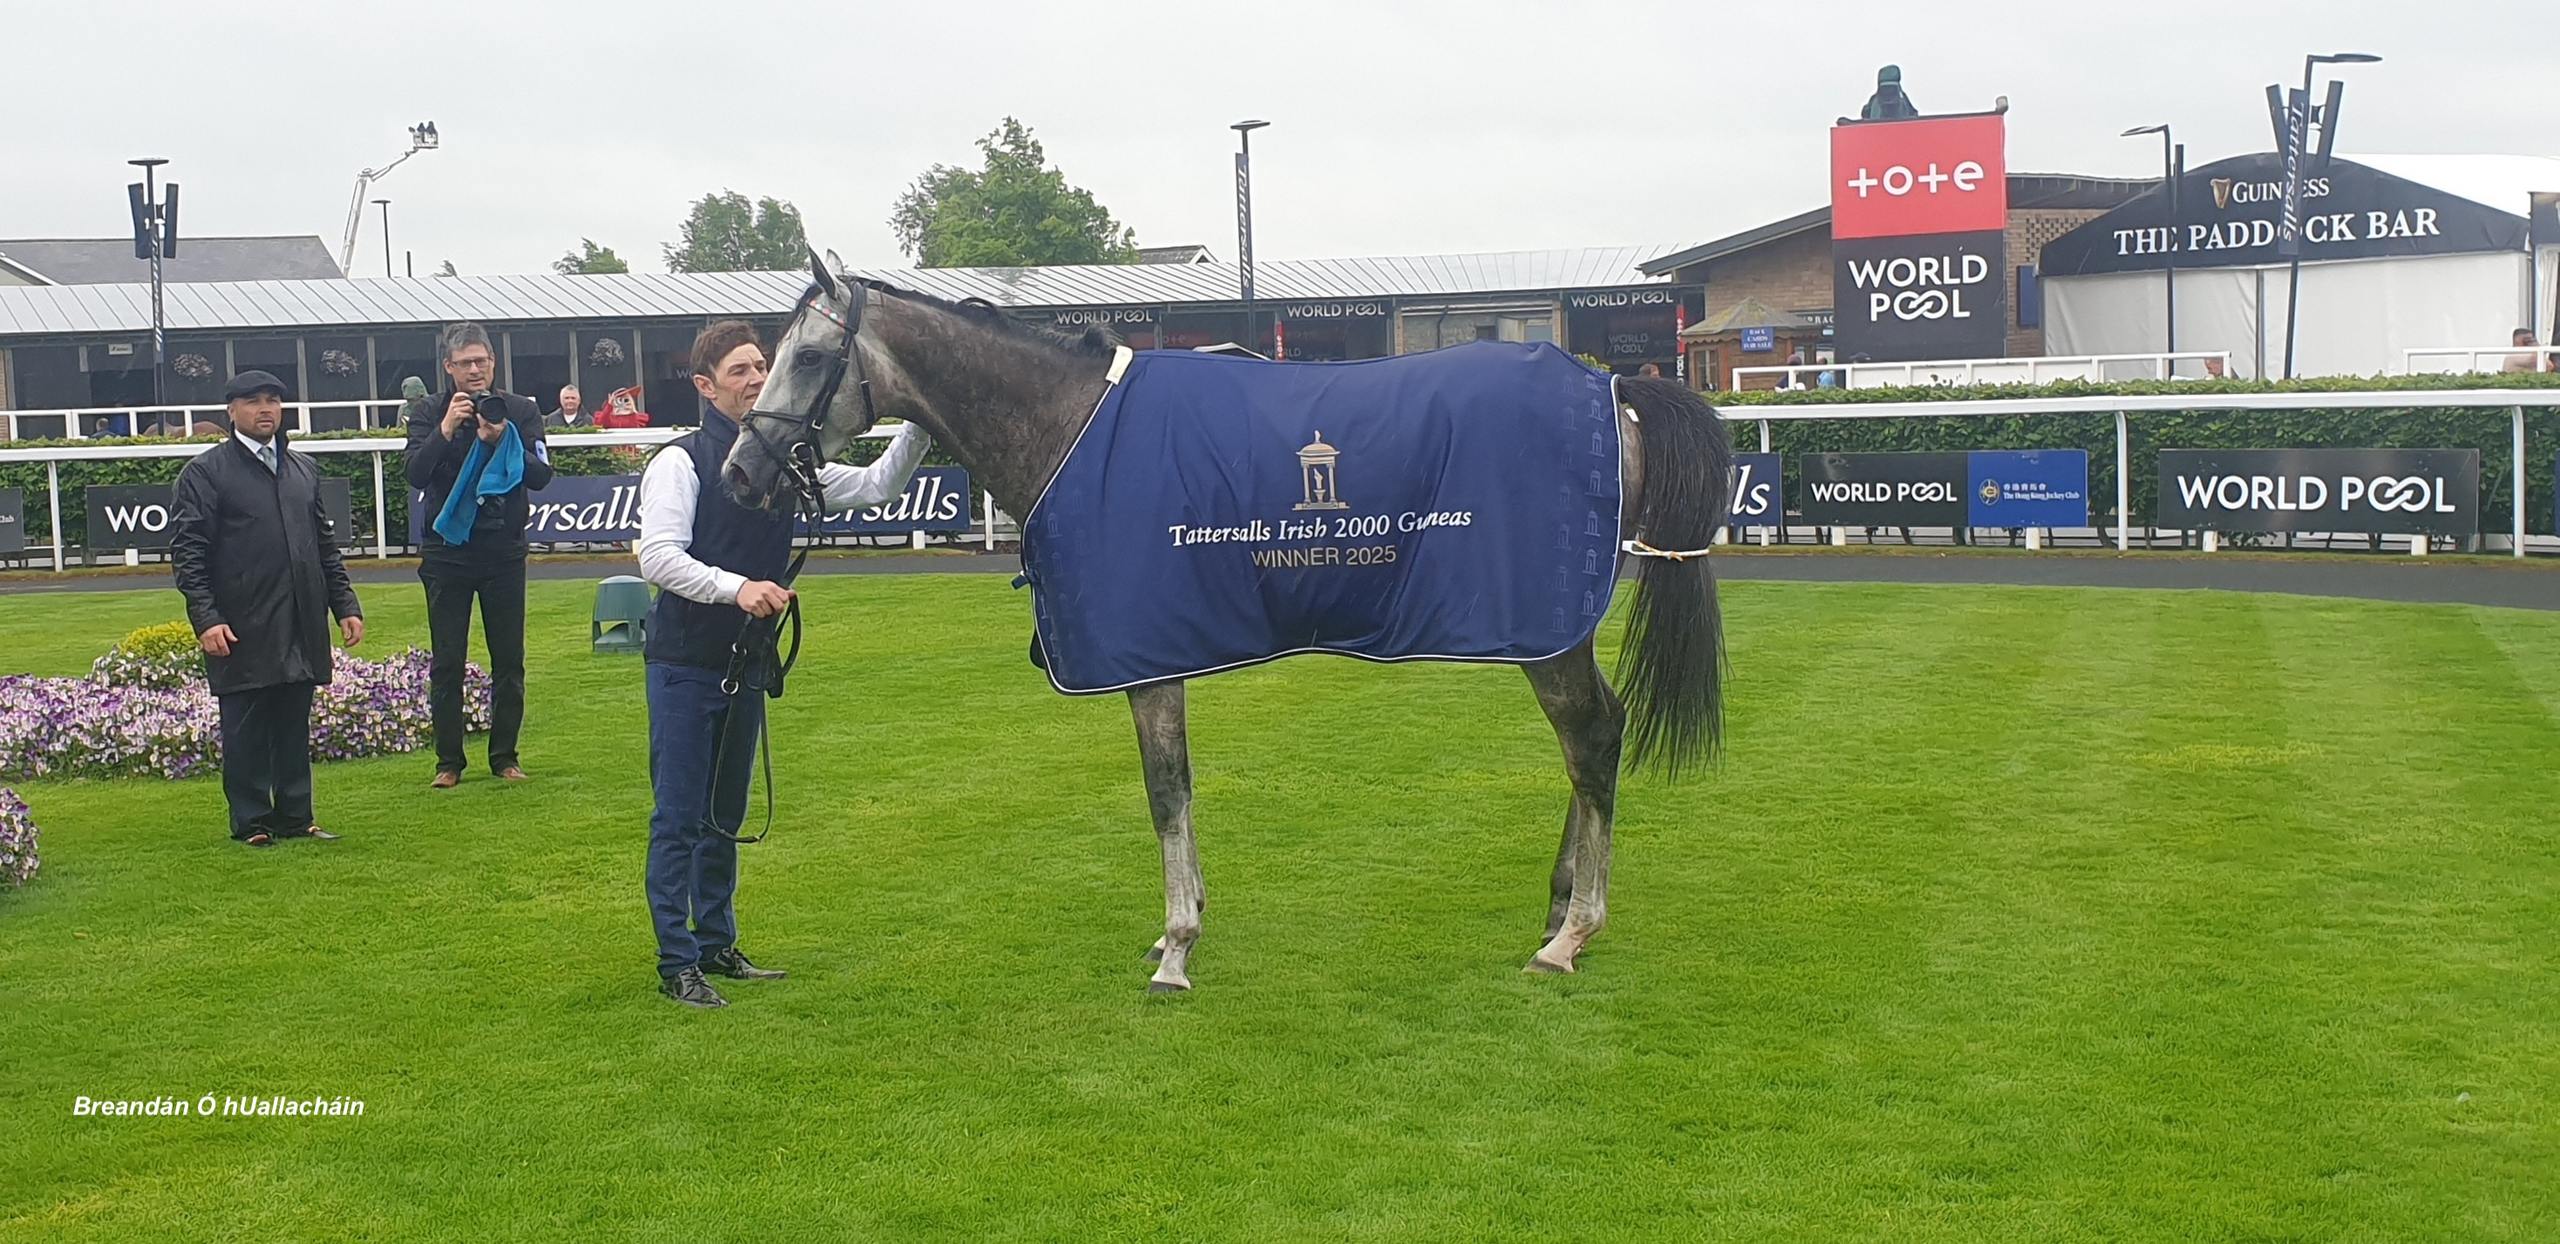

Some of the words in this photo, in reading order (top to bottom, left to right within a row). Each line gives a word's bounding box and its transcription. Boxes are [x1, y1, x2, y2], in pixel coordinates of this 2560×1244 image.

[1847, 161, 1984, 198] tote
[2283, 102, 2305, 242] Tattersalls
[2113, 226, 2178, 255] THE
[2188, 213, 2357, 250] PADDCK
[2366, 208, 2441, 239] BAR
[1847, 254, 1988, 289] WORLD
[1287, 305, 1342, 318] WORLD
[1345, 303, 1385, 317] POOL
[1571, 293, 1628, 308] WORLD
[1631, 291, 1674, 305] POOL
[1870, 289, 1971, 322] POOL
[1056, 311, 1111, 325] WORLD
[1114, 310, 1153, 323] POOL
[1811, 482, 1892, 502] WORLD
[1897, 482, 1958, 502] POOL
[2177, 475, 2328, 510] WORLD
[2341, 475, 2456, 513] POOL
[1168, 519, 1271, 547] Tattersalls
[1278, 516, 1327, 540] Irish
[1334, 514, 1390, 538] 2000
[1251, 547, 1341, 569] WINNER
[1345, 545, 1397, 567] 2025
